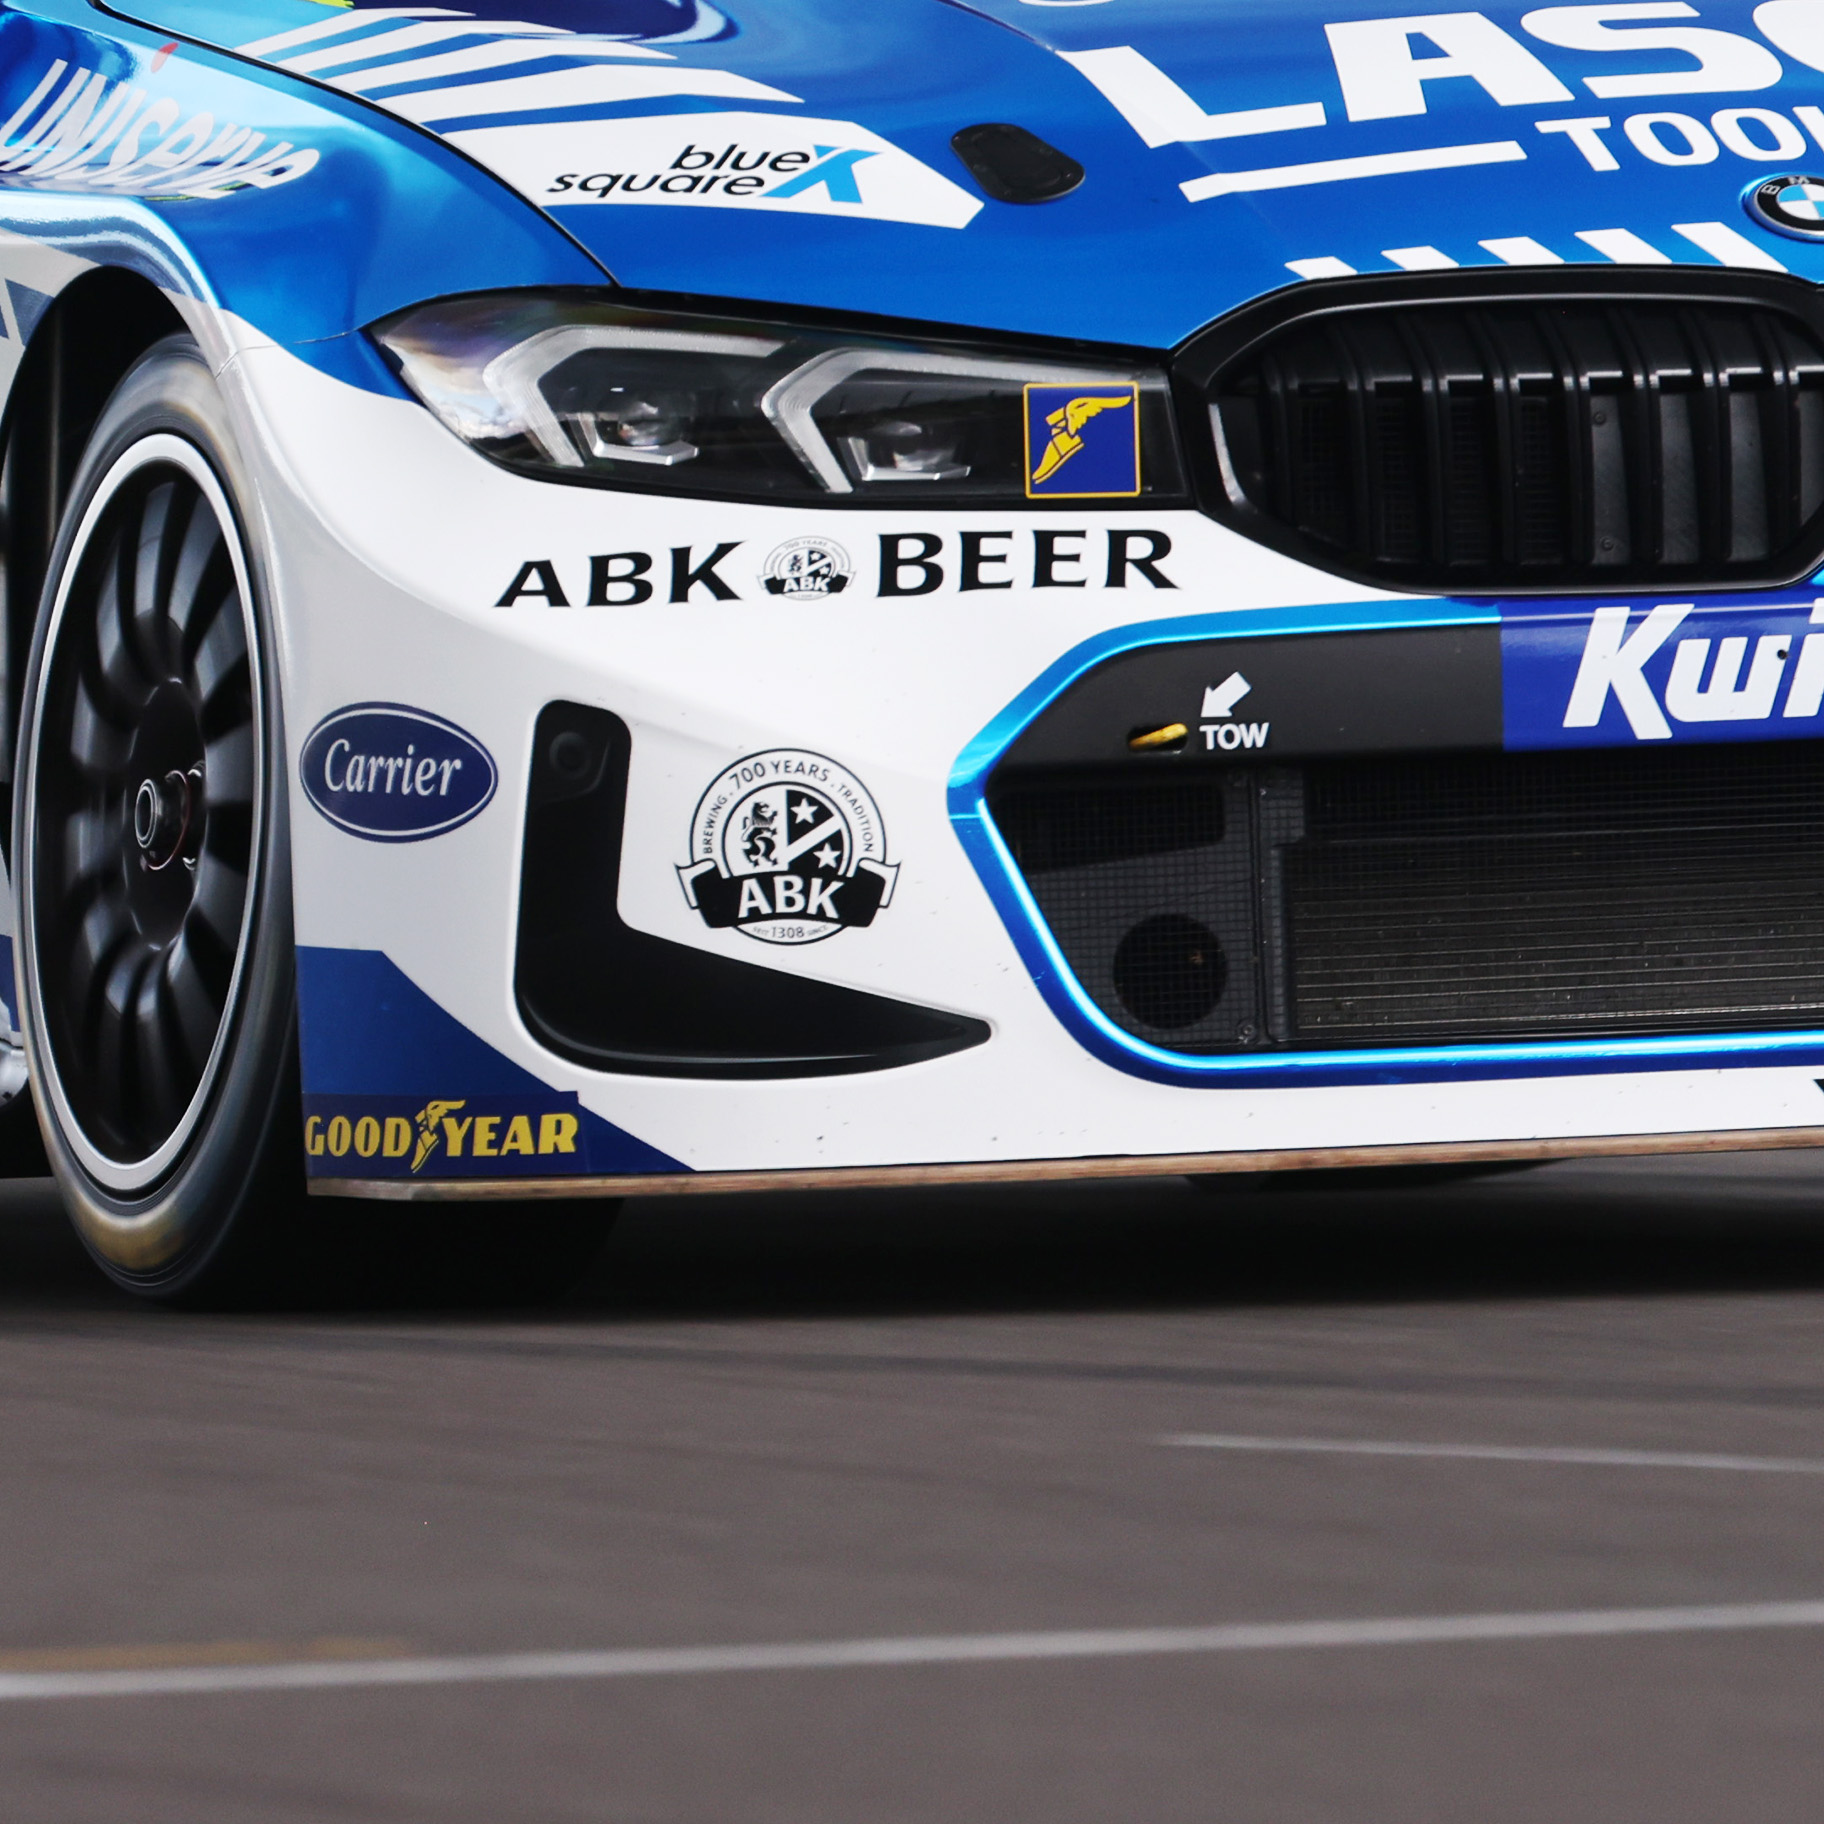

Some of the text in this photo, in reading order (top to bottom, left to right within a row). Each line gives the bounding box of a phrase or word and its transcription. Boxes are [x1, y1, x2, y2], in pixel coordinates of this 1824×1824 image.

[668, 143, 810, 173] blue
[546, 172, 765, 198] square
[493, 528, 1180, 608] ABK BEER
[782, 576, 832, 593] ABK
[1199, 722, 1269, 751] TOW
[323, 737, 463, 797] Carrier
[702, 759, 874, 855] BREWING 700 YEARS TRADITION
[738, 874, 845, 919] ABK
[770, 925, 806, 939] 1308
